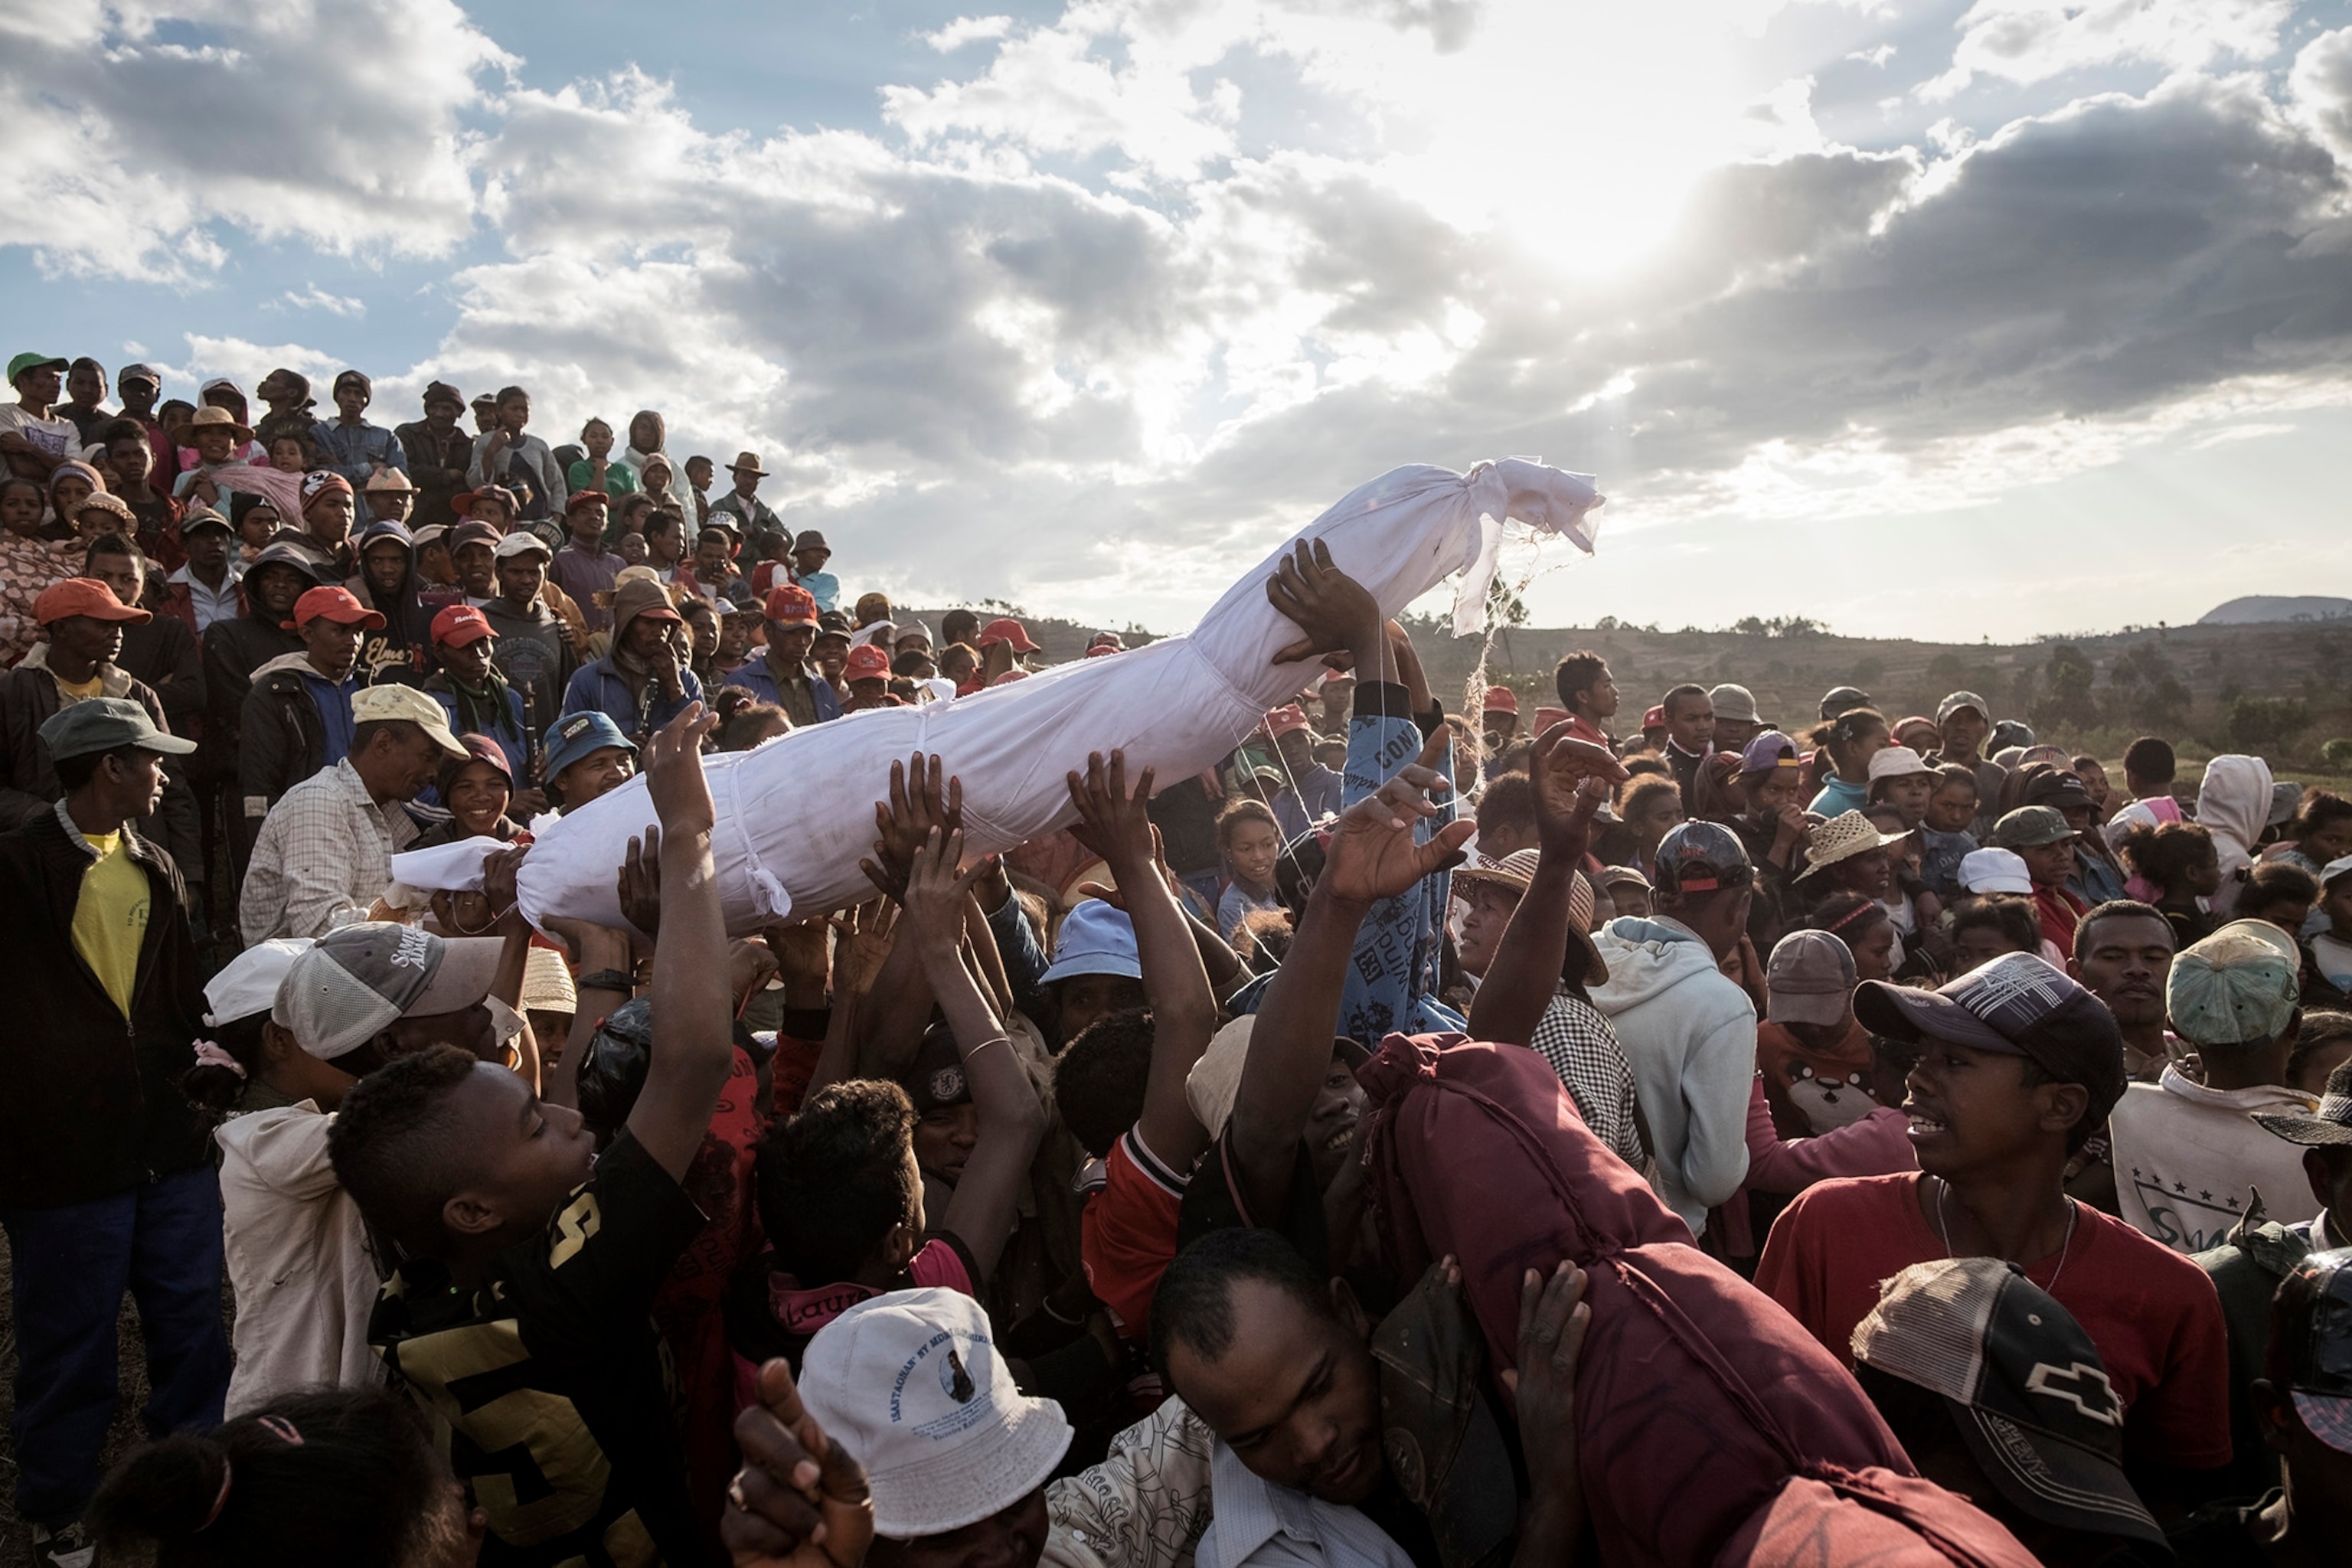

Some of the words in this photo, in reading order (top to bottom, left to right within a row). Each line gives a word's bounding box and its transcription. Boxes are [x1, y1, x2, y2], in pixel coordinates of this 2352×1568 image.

[364, 636, 404, 665] Elmo
[1358, 950, 1383, 982] 63
[1374, 932, 1410, 993] wind
[1991, 1414, 2052, 1476] CHEVY
